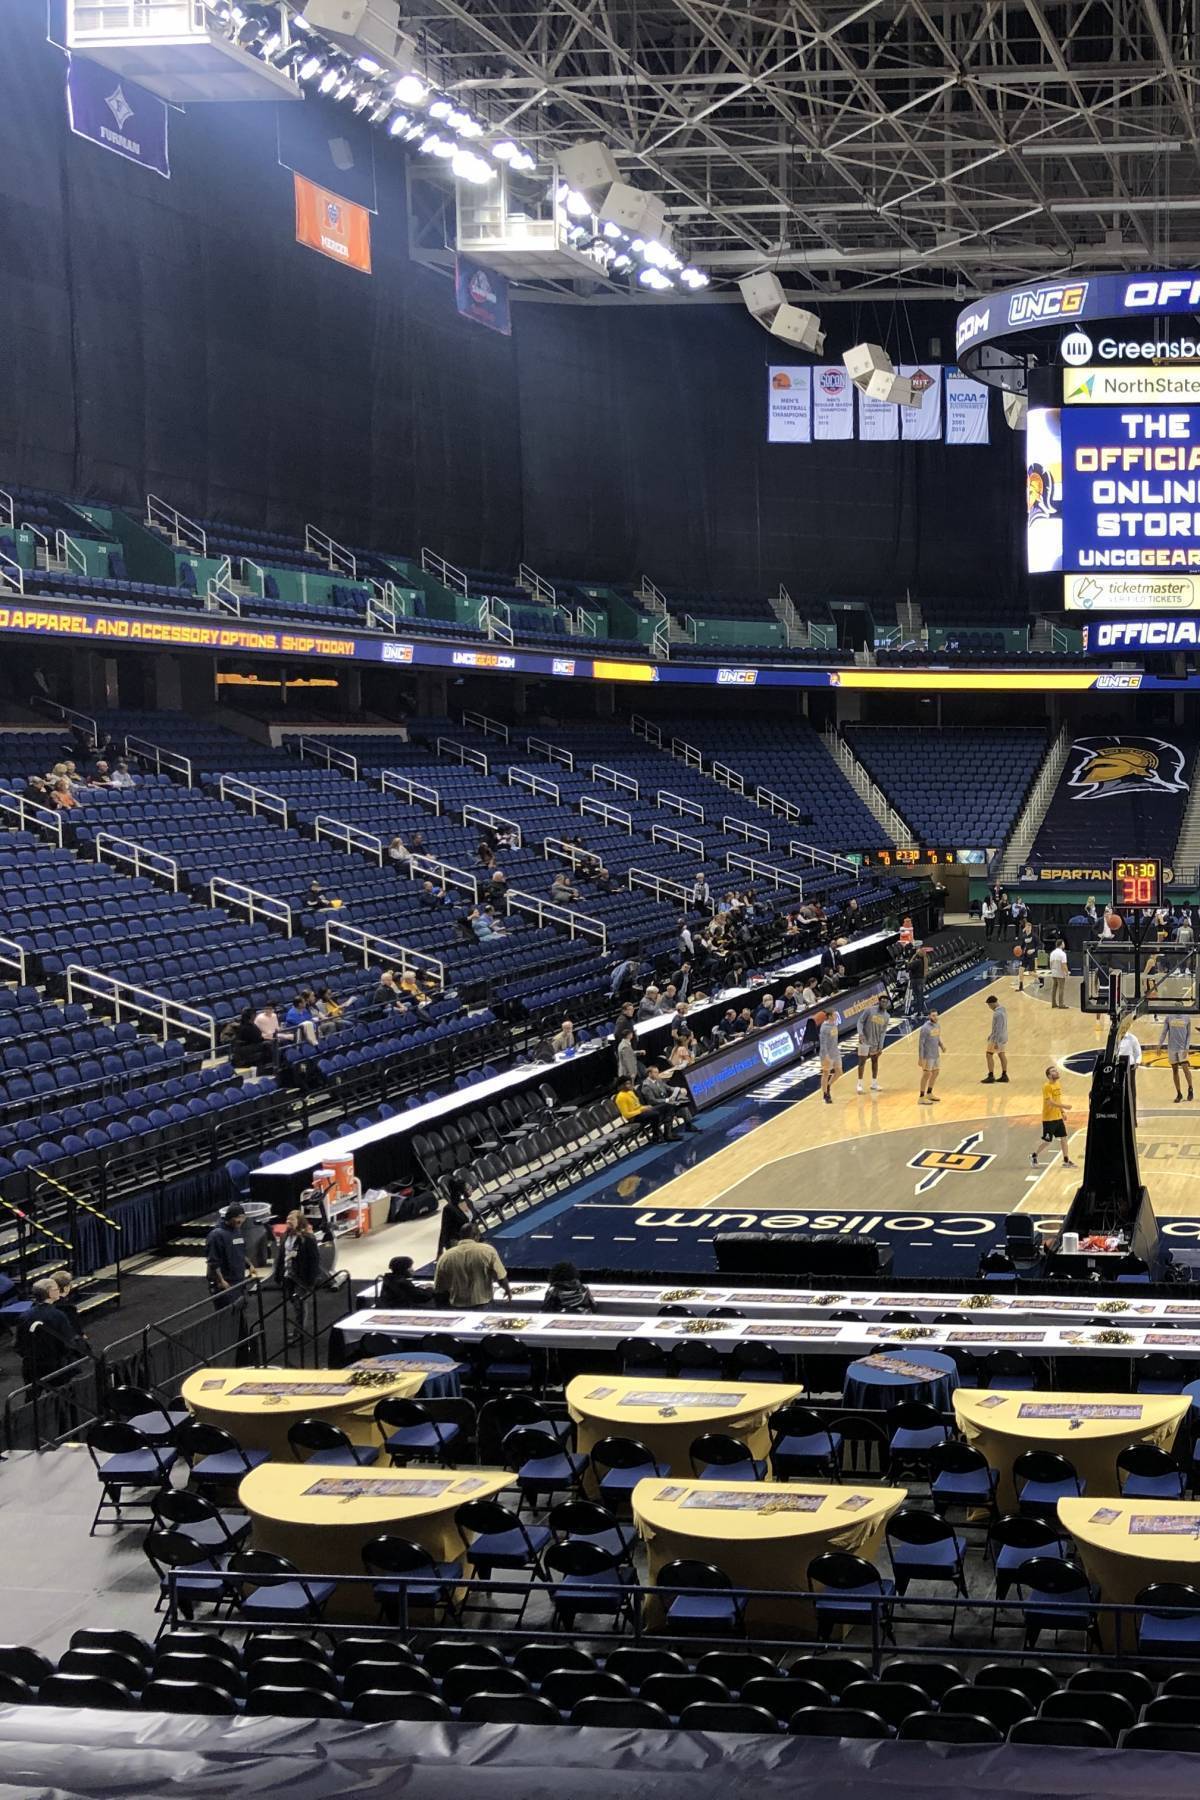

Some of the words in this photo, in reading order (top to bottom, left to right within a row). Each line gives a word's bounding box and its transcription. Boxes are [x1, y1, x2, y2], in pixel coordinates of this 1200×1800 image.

[1009, 285, 1086, 322] UNCG
[1105, 378, 1200, 393] NorthState
[949, 394, 977, 402] NCAA
[1121, 414, 1190, 439] THE
[1108, 582, 1186, 593] ticketmaster
[11, 611, 93, 634] APPAREL
[95, 619, 129, 637] AND
[130, 622, 219, 645] ACCESSORY
[220, 630, 279, 648] OPTIONS.
[281, 635, 314, 652] SHOP
[315, 639, 355, 656] TODAY!
[717, 670, 757, 684] UNCG
[1098, 675, 1141, 688] UNCG
[896, 850, 920, 860] 27:30
[1040, 870, 1112, 880] SPARTAN
[1117, 864, 1156, 877] 27:30
[1124, 878, 1152, 902] 30
[634, 1211, 996, 1236] Coliseum
